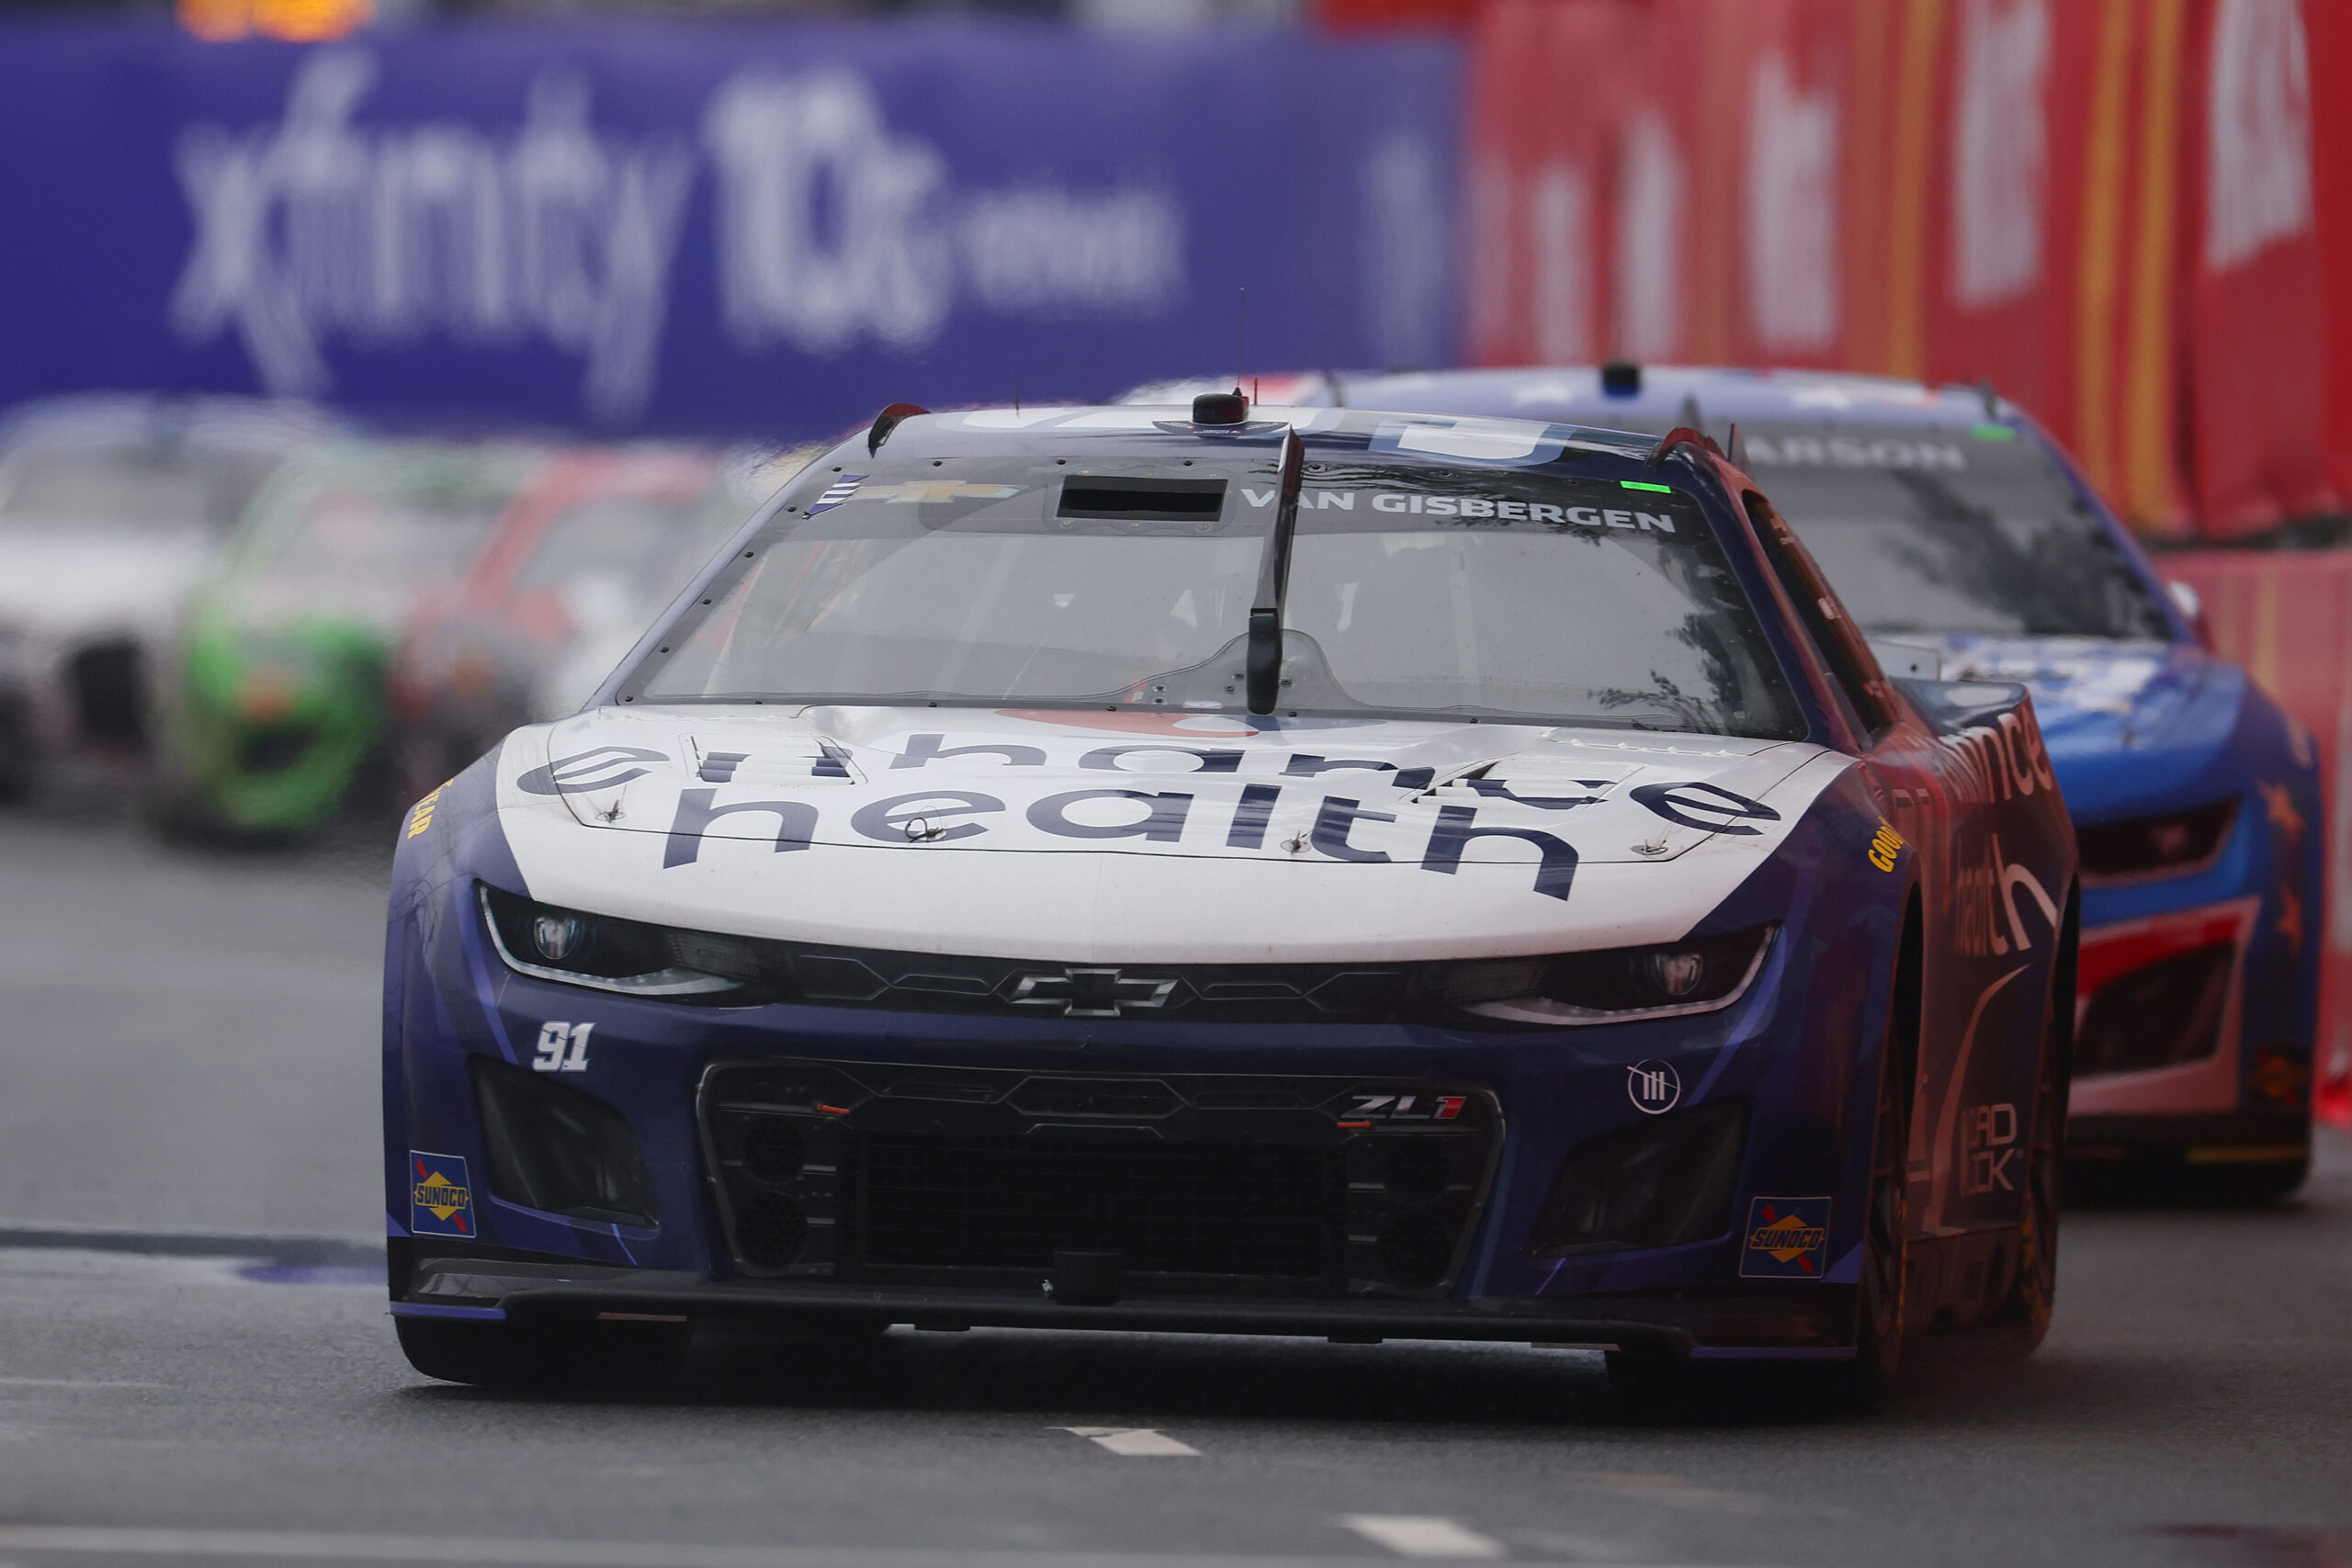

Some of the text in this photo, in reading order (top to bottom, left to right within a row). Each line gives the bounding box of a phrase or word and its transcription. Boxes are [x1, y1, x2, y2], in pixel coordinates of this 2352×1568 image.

[1744, 434, 1965, 472] ARSON
[1372, 493, 1677, 534] GISBERGEN
[662, 782, 1580, 902] health
[532, 1021, 596, 1072] 91
[1340, 1095, 1467, 1120] ZL1
[415, 1184, 467, 1207] SUNOCO
[1749, 1228, 1825, 1249] SUNOCO
